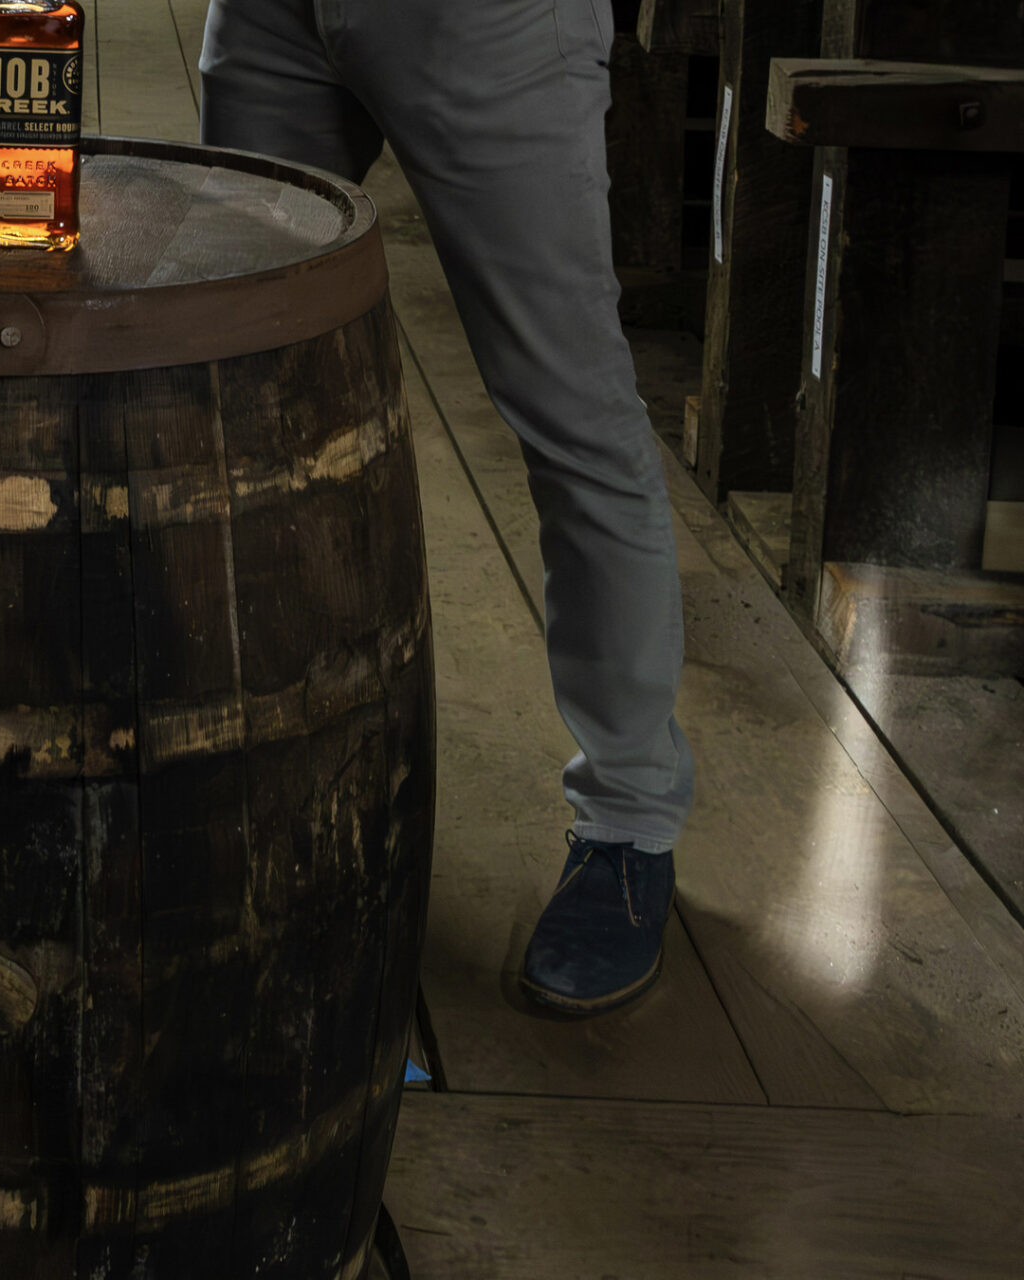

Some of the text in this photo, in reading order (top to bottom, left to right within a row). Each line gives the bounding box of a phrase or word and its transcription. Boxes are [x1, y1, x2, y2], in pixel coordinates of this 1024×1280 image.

[24, 122, 55, 132] SELECT
[1, 160, 56, 173] CREEK
[4, 175, 56, 188] BATCH
[821, 200, 830, 235] KCSB
[817, 238, 826, 295] ON-SITE
[815, 299, 823, 335] POOL
